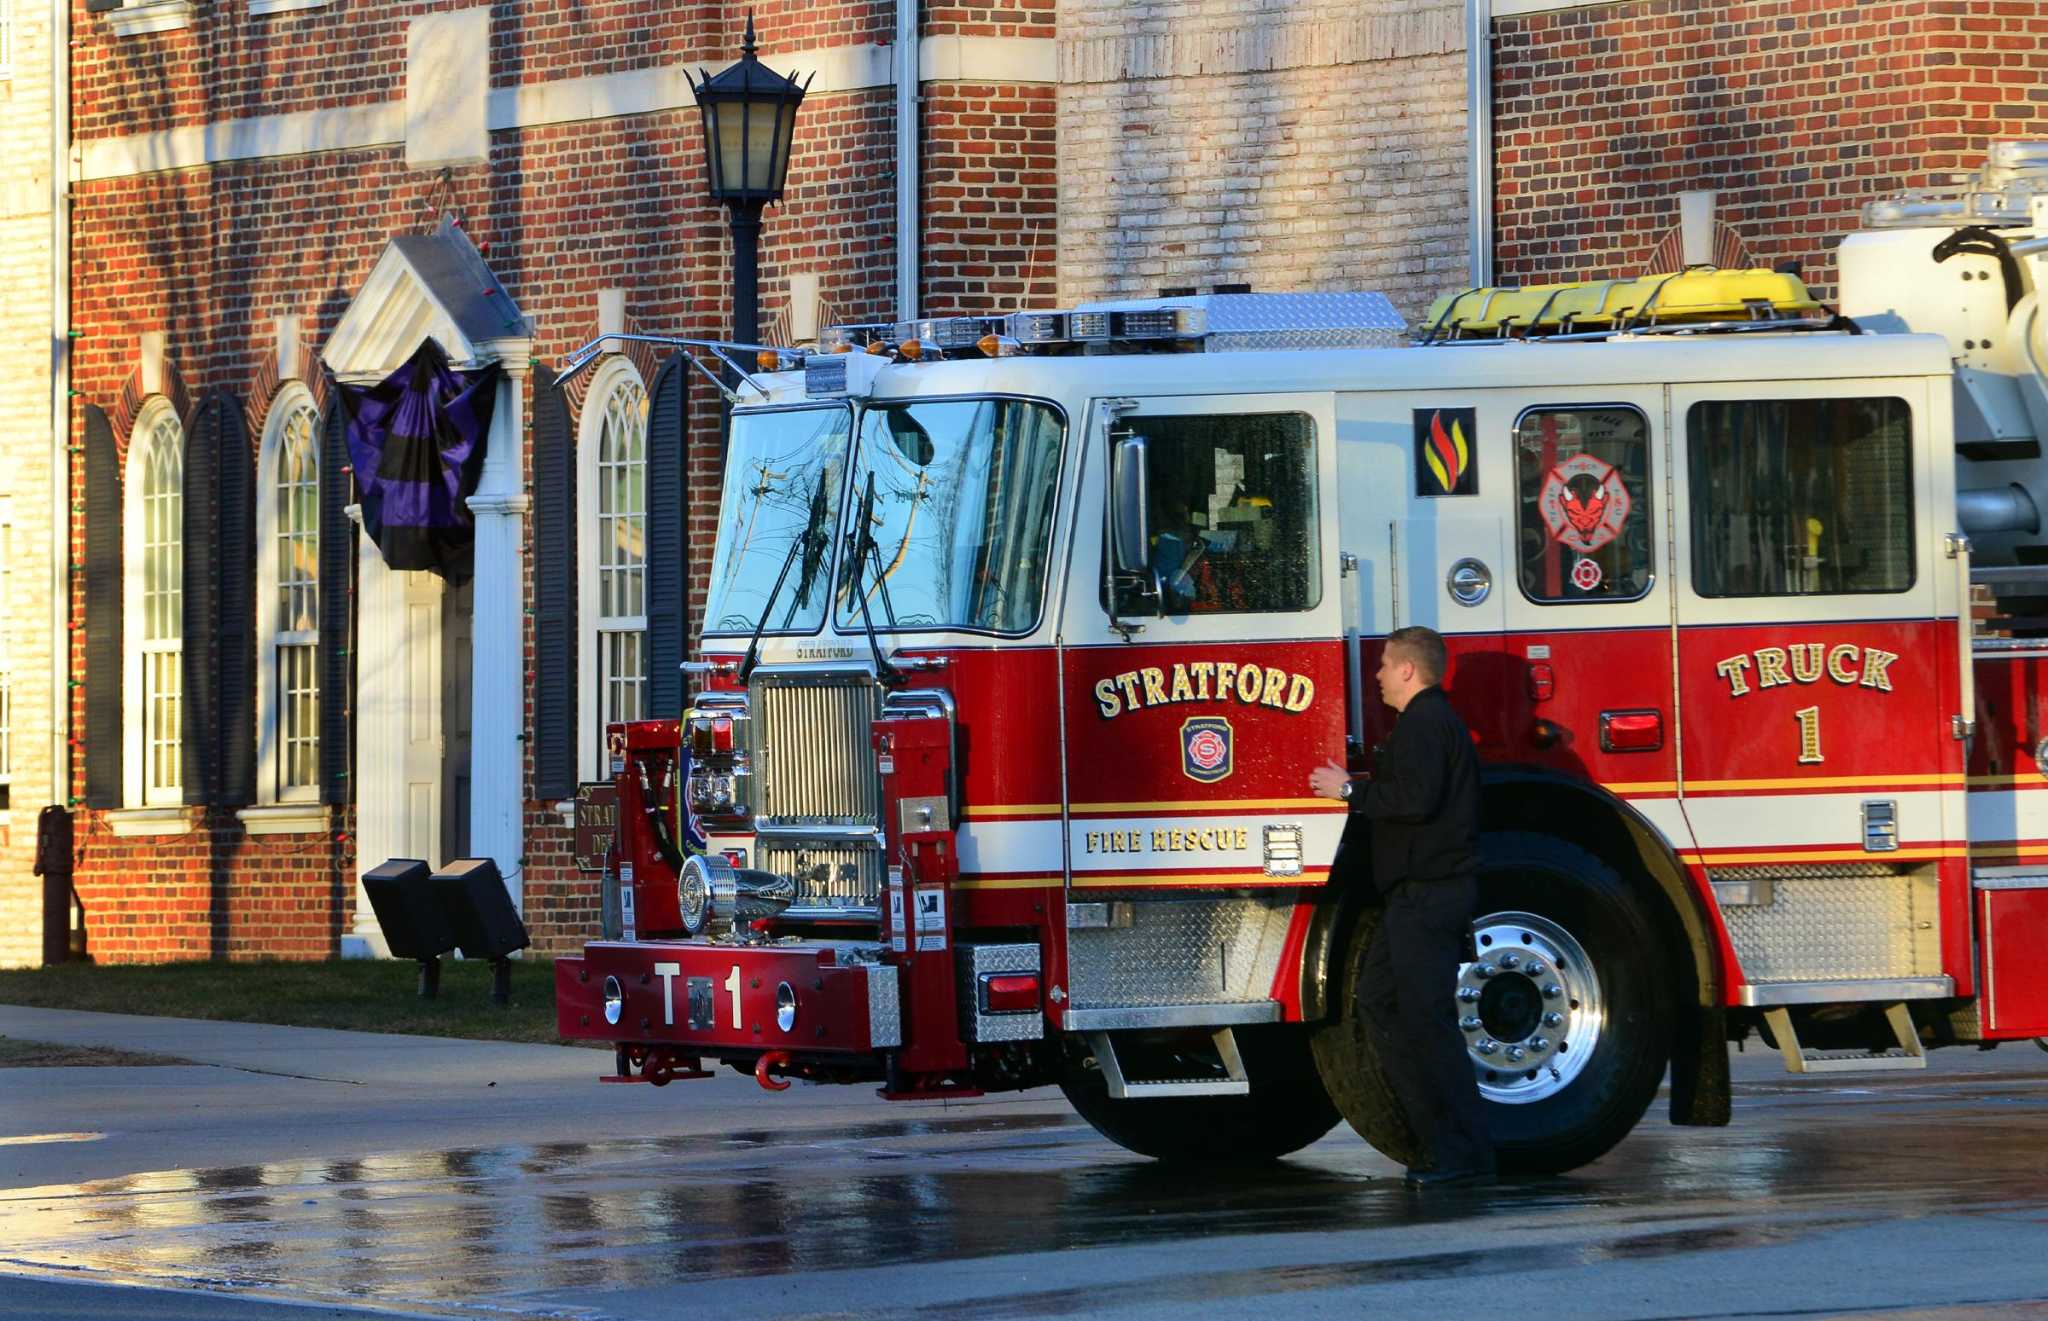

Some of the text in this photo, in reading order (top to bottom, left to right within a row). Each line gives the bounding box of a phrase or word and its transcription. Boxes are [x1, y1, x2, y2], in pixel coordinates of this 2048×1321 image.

[796, 640, 854, 659] STRATFORD
[1716, 643, 1900, 696] TRUCK
[1094, 662, 1315, 718] STRATFORD
[1795, 705, 1825, 763] 1
[1087, 826, 1248, 852] FIRE RESCUE
[654, 962, 743, 1029] T 1
